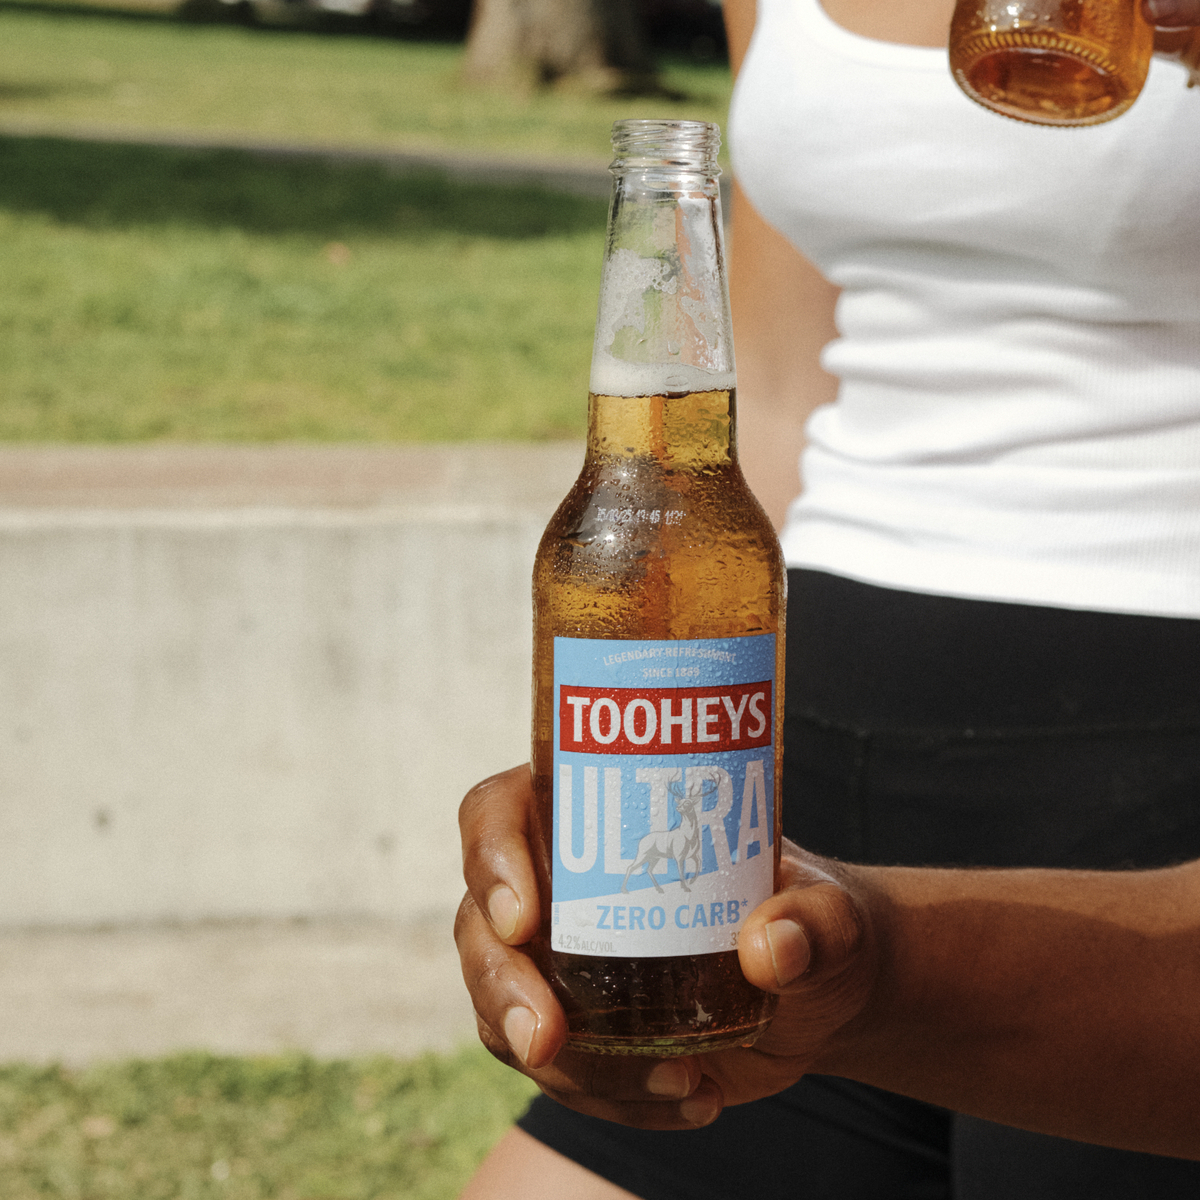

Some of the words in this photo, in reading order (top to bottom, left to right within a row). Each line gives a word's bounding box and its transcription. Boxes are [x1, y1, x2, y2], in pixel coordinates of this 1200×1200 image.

[603, 647, 662, 666] LEGENDARY
[665, 646, 737, 663] REFRESHMENT
[642, 667, 673, 678] SINCE
[675, 667, 700, 678] 1869
[566, 691, 766, 744] TOOHEYS
[558, 759, 770, 875] ULTRA
[596, 904, 666, 930] ZERO
